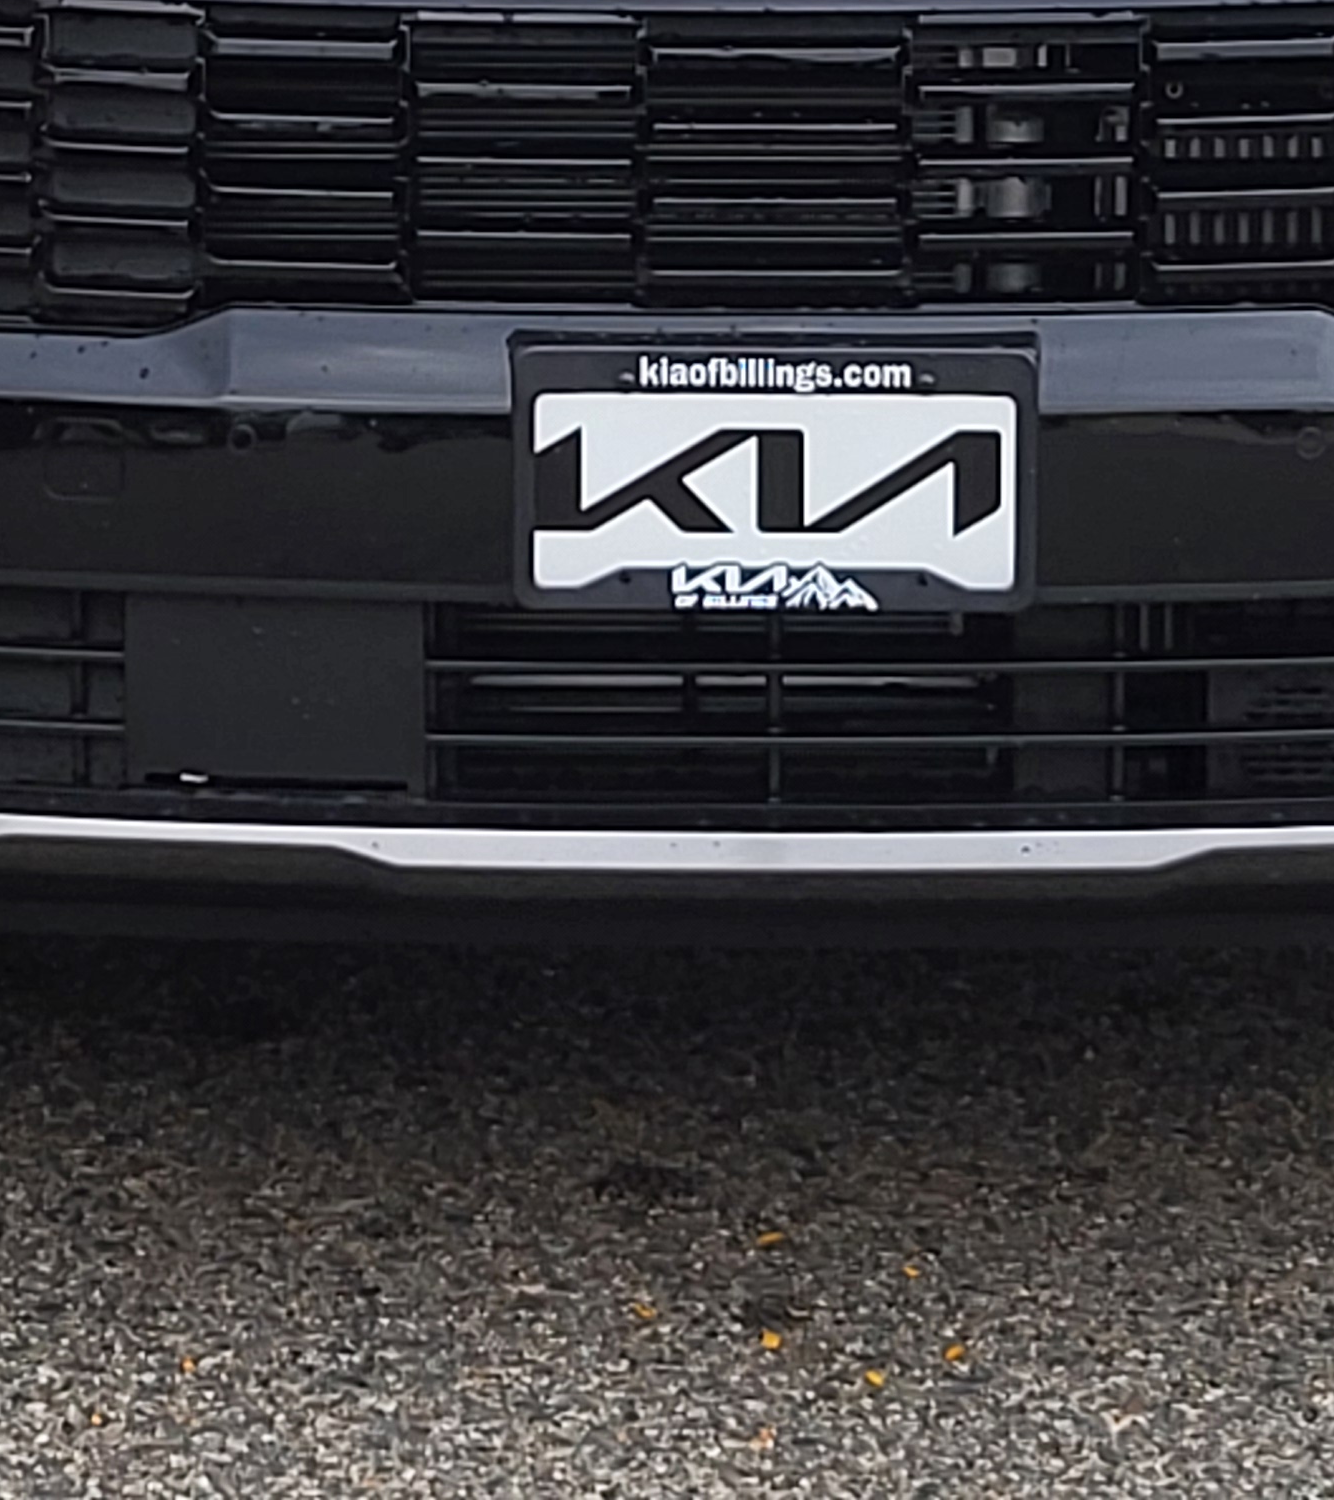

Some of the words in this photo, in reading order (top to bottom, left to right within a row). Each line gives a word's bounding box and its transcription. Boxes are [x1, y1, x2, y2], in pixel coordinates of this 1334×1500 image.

[638, 355, 912, 392] kiaofbillings.com
[533, 426, 1002, 538] KIA
[671, 564, 788, 594] KIA
